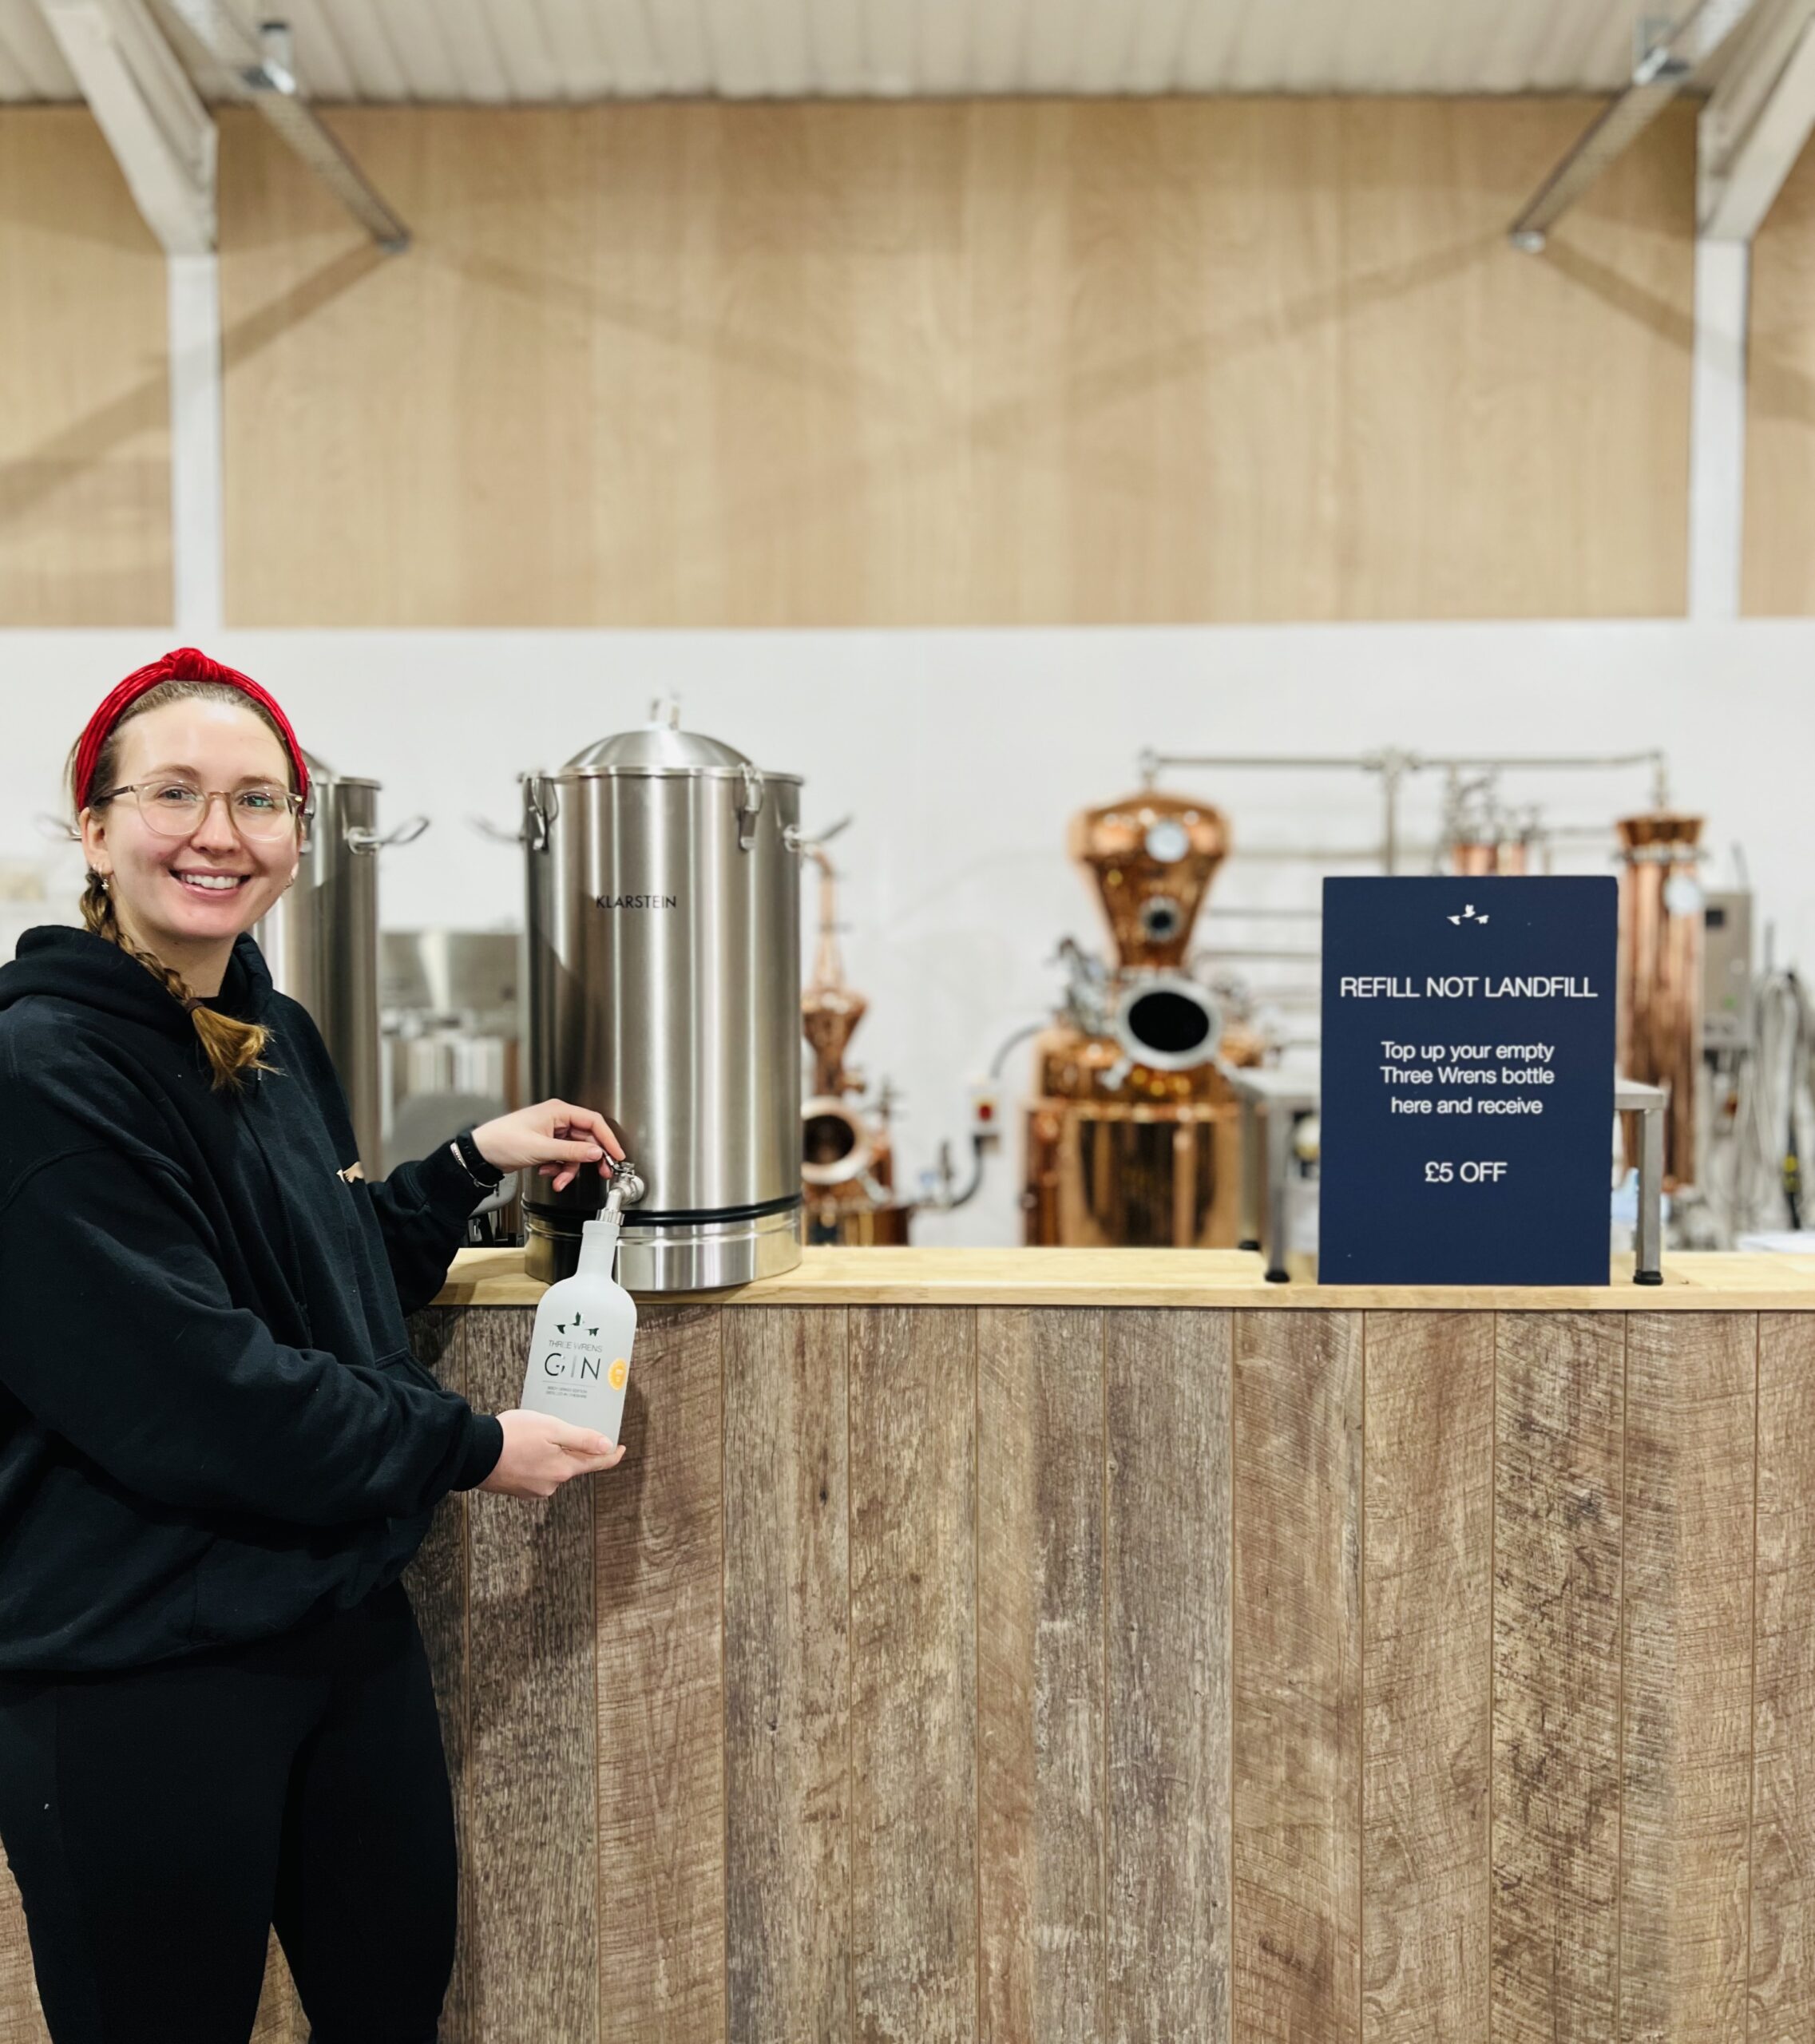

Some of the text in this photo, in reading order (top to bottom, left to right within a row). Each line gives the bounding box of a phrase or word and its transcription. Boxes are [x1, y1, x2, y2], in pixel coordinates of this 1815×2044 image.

[596, 895, 676, 909] KLARSTEIN
[1340, 976, 1599, 998] REFILL NOT LANDFILL
[1381, 1040, 1555, 1063] Top up your empty
[1379, 1066, 1555, 1084] Three Wrens bottle
[1391, 1096, 1544, 1115] here and receive
[1425, 1161, 1508, 1183] £5 OFF
[545, 1353, 600, 1380] GIN
